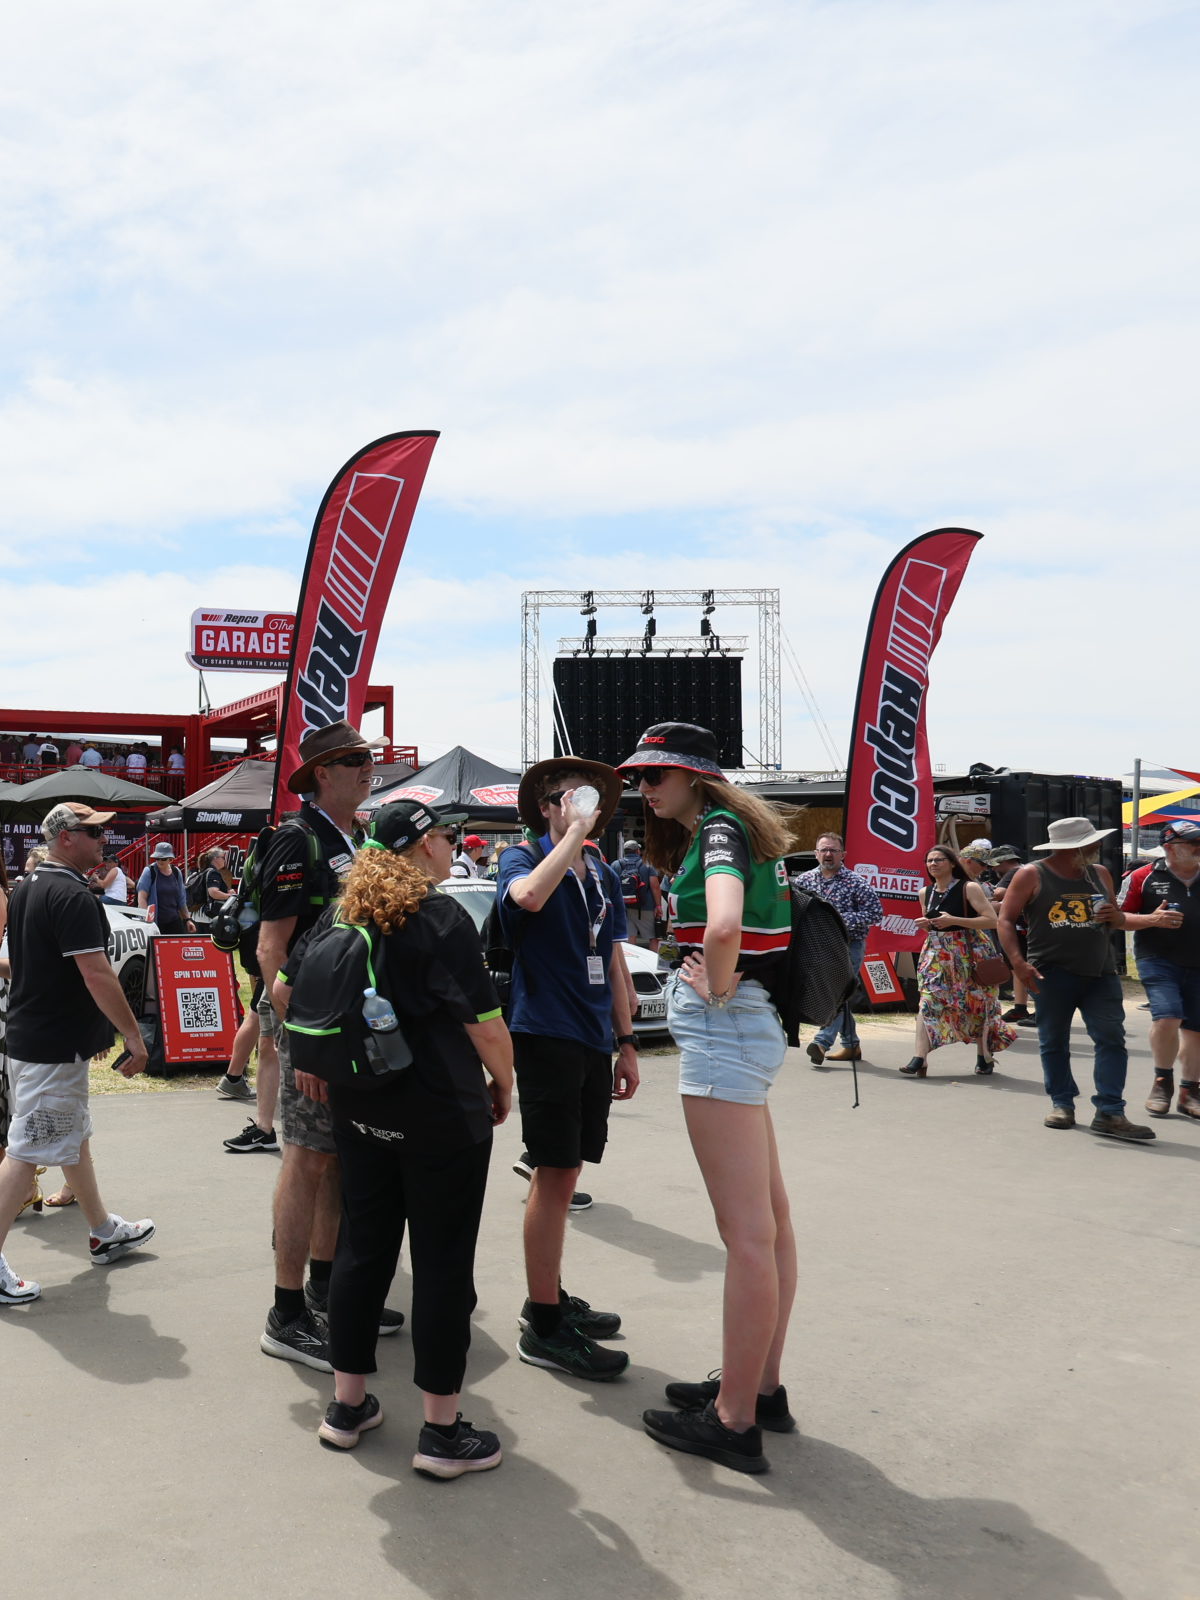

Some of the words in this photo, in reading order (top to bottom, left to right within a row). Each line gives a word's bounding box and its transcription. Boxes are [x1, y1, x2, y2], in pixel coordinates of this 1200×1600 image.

[223, 613, 259, 624] Repco
[269, 618, 295, 631] The
[201, 629, 290, 654] GARAGE
[296, 595, 367, 744] Rep
[864, 660, 925, 852] Repco
[196, 811, 242, 822] ShowTime
[13, 825, 32, 834] AND
[861, 875, 919, 892] ARAGE
[108, 928, 146, 962] epco
[174, 970, 191, 978] SPIN
[192, 970, 201, 978] TO
[202, 970, 217, 978] WIN
